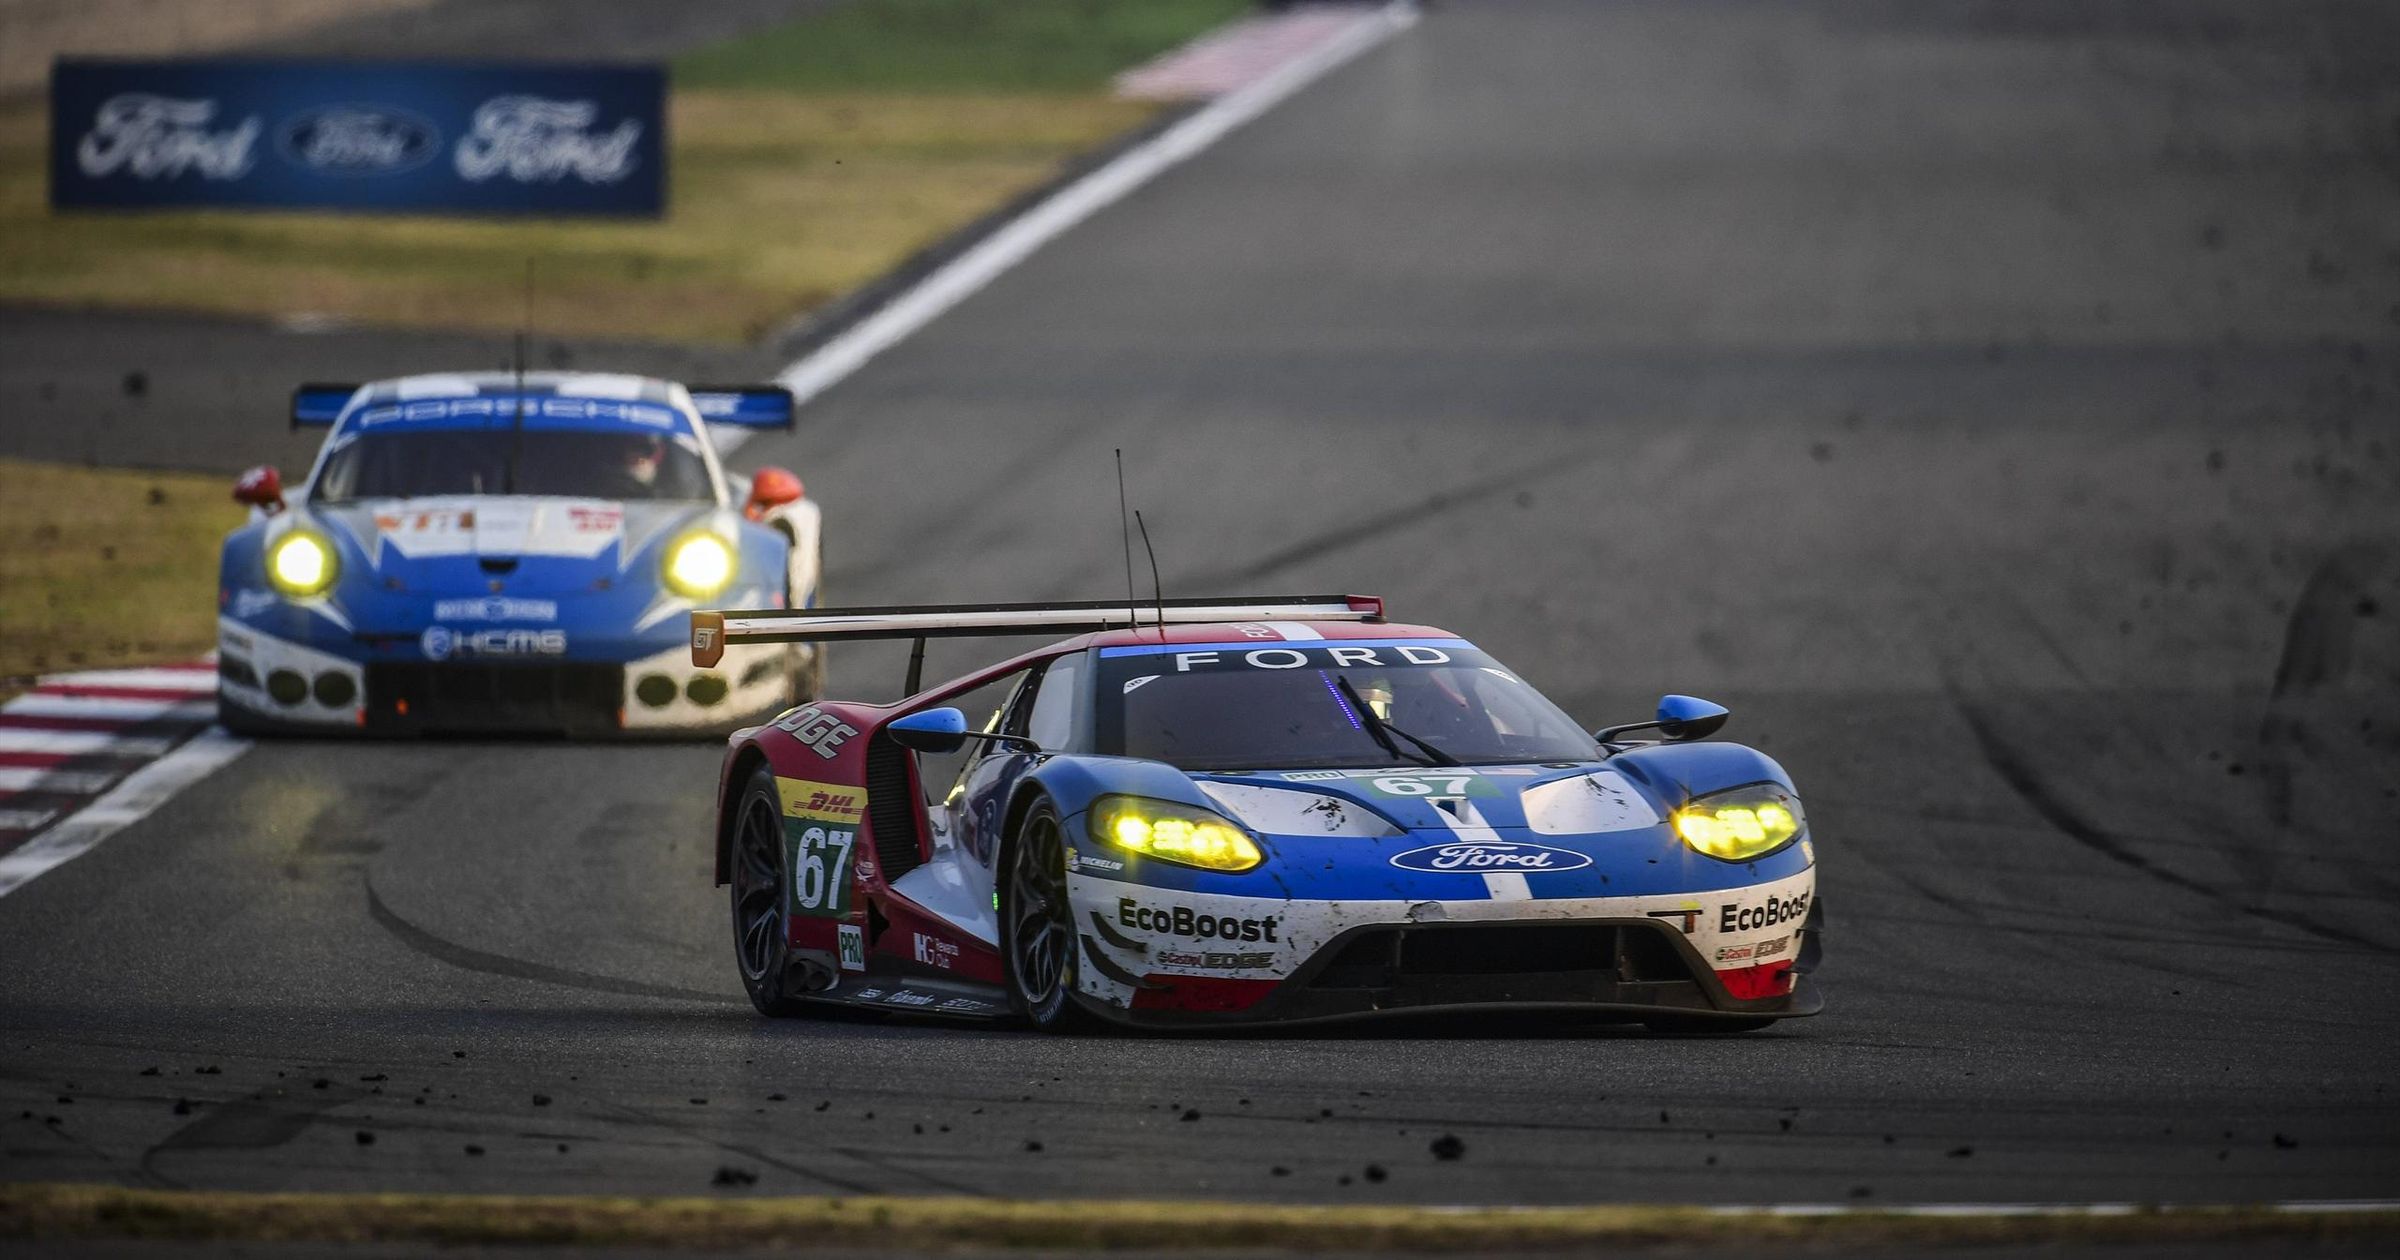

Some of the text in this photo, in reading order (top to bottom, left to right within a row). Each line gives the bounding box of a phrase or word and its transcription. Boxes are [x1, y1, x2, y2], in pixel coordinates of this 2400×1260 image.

[78, 94, 262, 180] Ford
[454, 96, 642, 183] Ford
[693, 628, 719, 651] GT
[1176, 646, 1451, 672] FORD
[776, 706, 859, 760] DGE
[1372, 776, 1473, 795] 67
[807, 792, 855, 814] DHL
[796, 827, 853, 909] 67
[1079, 856, 1124, 871] MICHELIN
[1431, 846, 1552, 868] Ford
[1118, 897, 1278, 943] EcoBoost
[840, 931, 862, 964] PRO
[1204, 952, 1275, 969] EDGE
